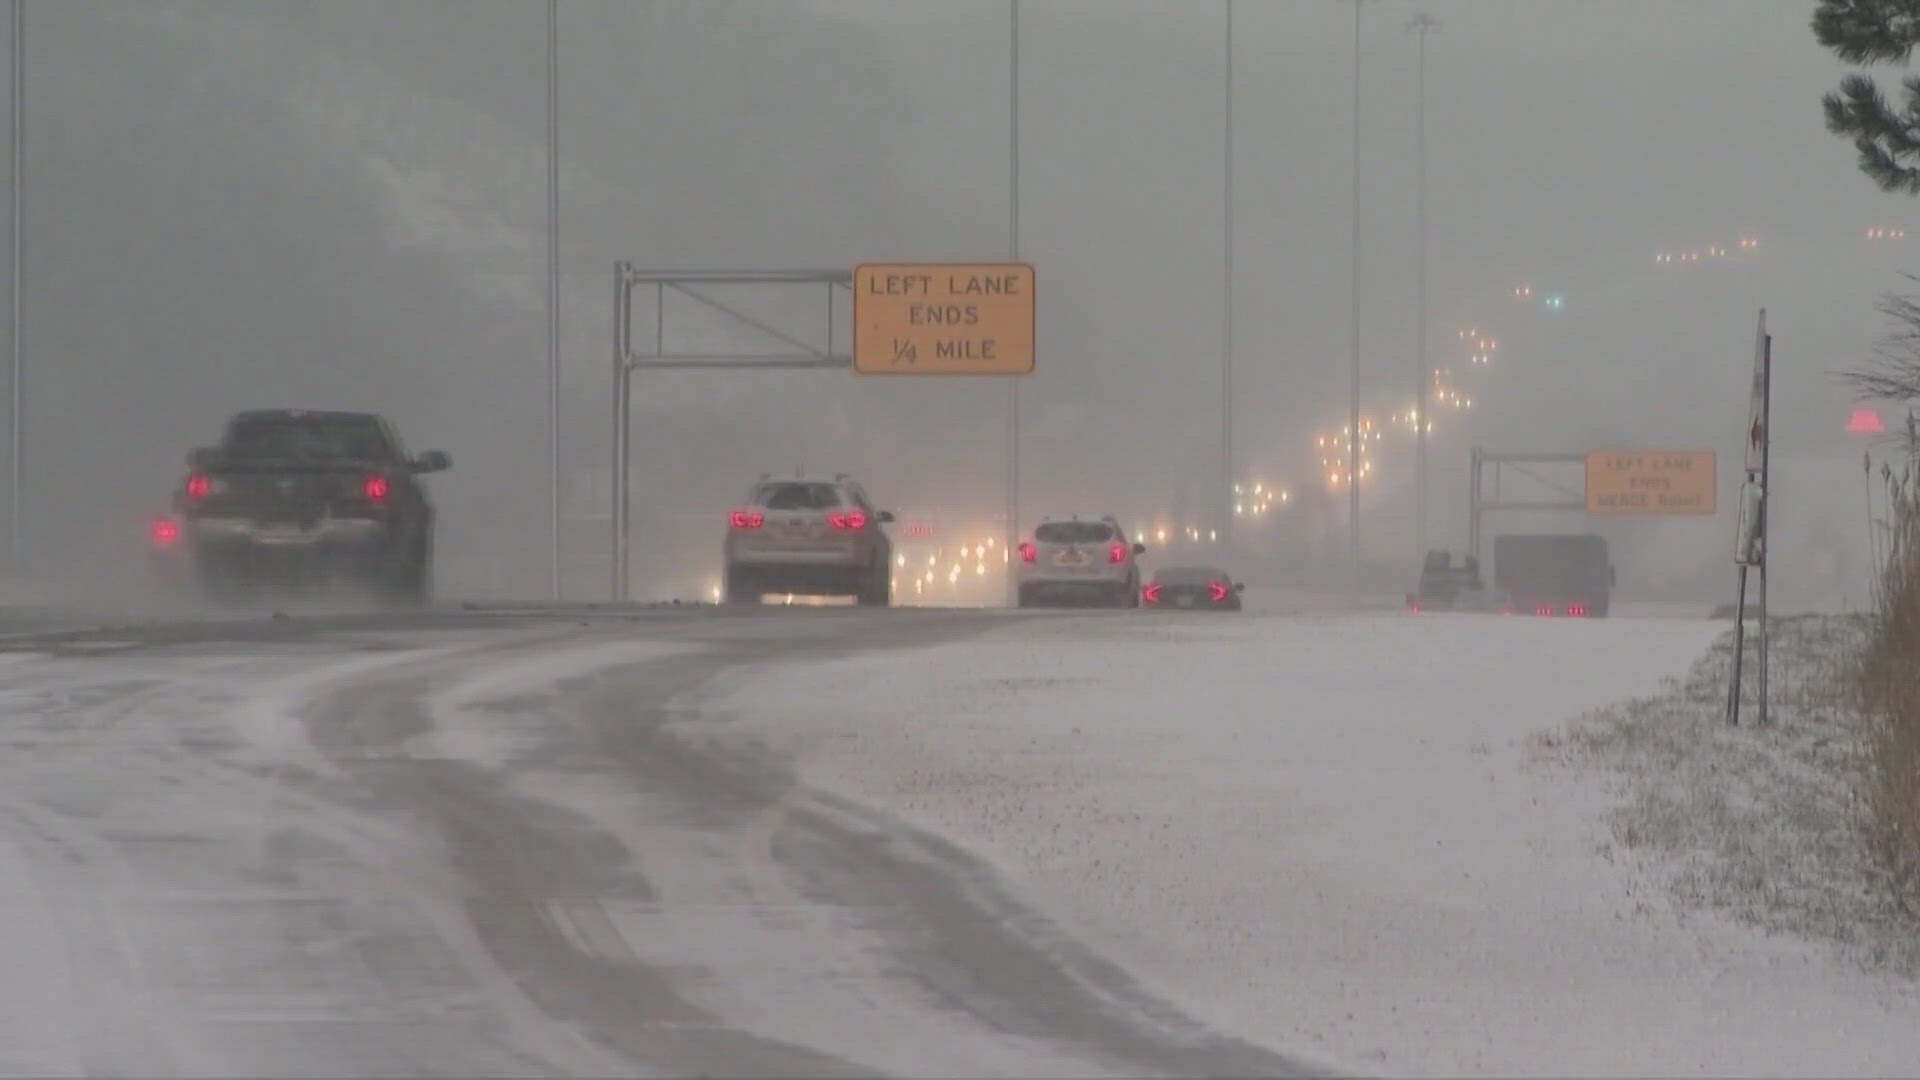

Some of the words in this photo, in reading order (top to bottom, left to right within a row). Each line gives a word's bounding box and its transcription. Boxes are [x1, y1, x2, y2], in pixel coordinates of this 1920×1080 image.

[870, 274, 932, 295] LEFT
[949, 274, 1018, 295] LANE
[910, 305, 978, 325] ENDS
[936, 340, 996, 360] MILE
